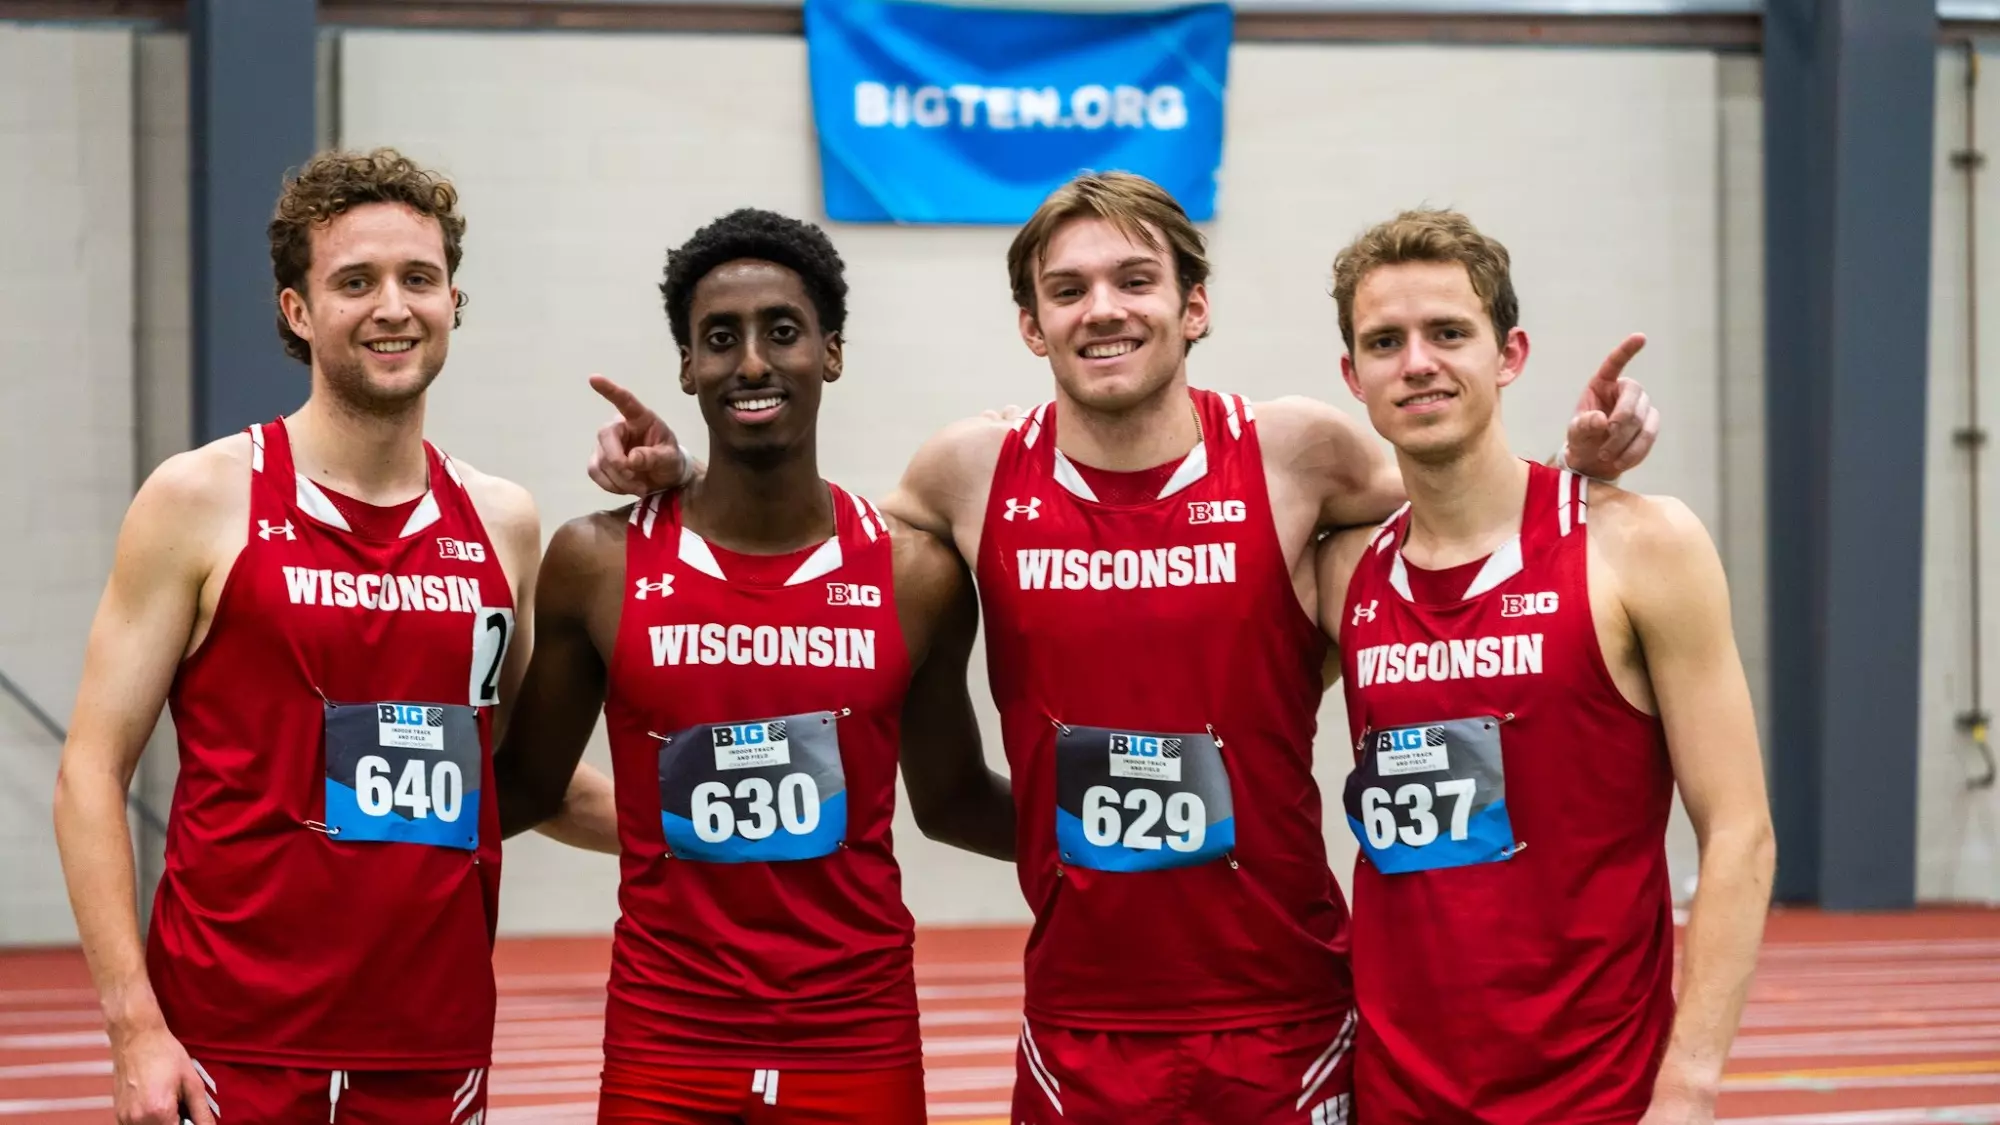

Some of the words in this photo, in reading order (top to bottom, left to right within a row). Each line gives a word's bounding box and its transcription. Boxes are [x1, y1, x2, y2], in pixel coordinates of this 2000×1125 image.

[854, 81, 1188, 130] BIGTEN.ORG
[282, 566, 483, 614] WISCONSIN
[1016, 542, 1237, 591] WISCONSIN
[480, 612, 507, 701] 2
[648, 622, 876, 670] WISCONSIN
[1356, 633, 1544, 689] WISCONSIN
[355, 755, 463, 823] 640
[1147, 759, 1167, 767] TRACK
[691, 772, 821, 844] 630
[1082, 785, 1207, 853] 629
[1361, 778, 1477, 850] 637
